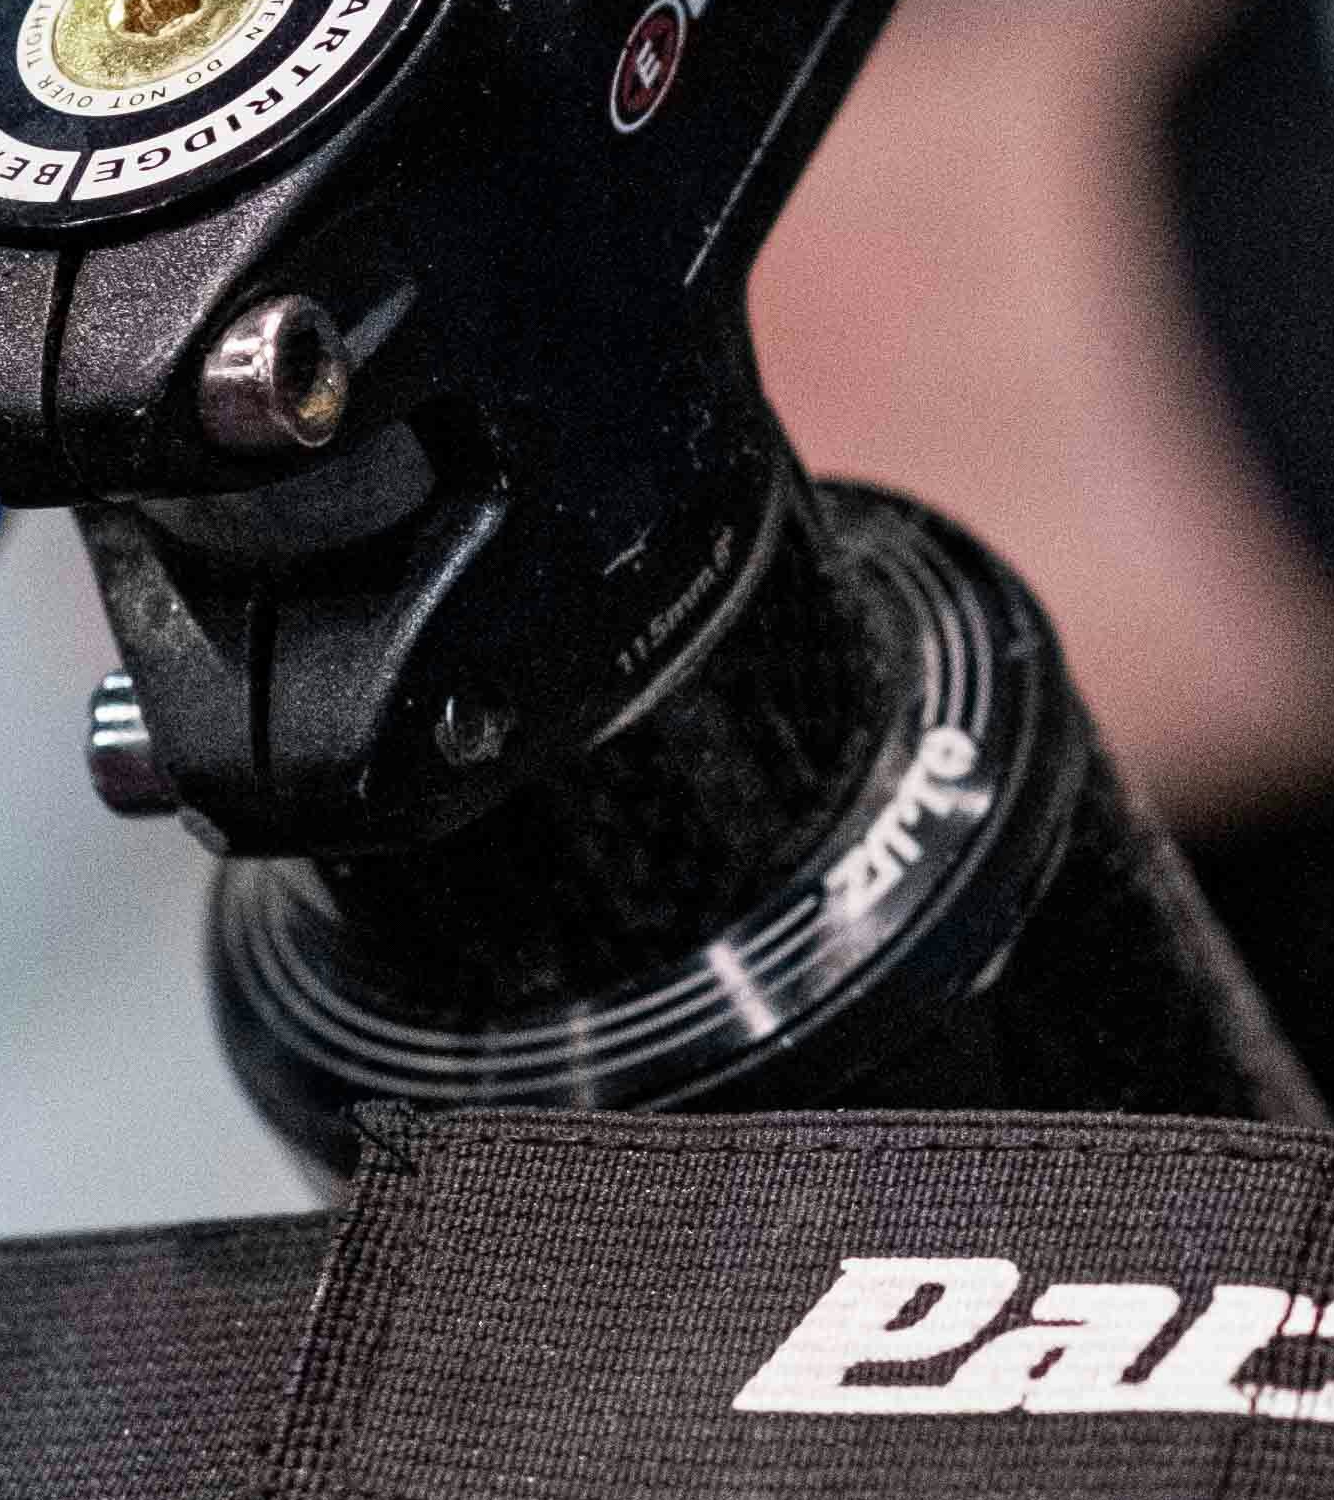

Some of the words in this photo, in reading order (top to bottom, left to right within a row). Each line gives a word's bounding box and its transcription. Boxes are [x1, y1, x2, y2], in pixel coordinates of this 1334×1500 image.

[186, 58, 223, 84] DO
[37, 74, 93, 108] OVER
[108, 86, 166, 109] NOT
